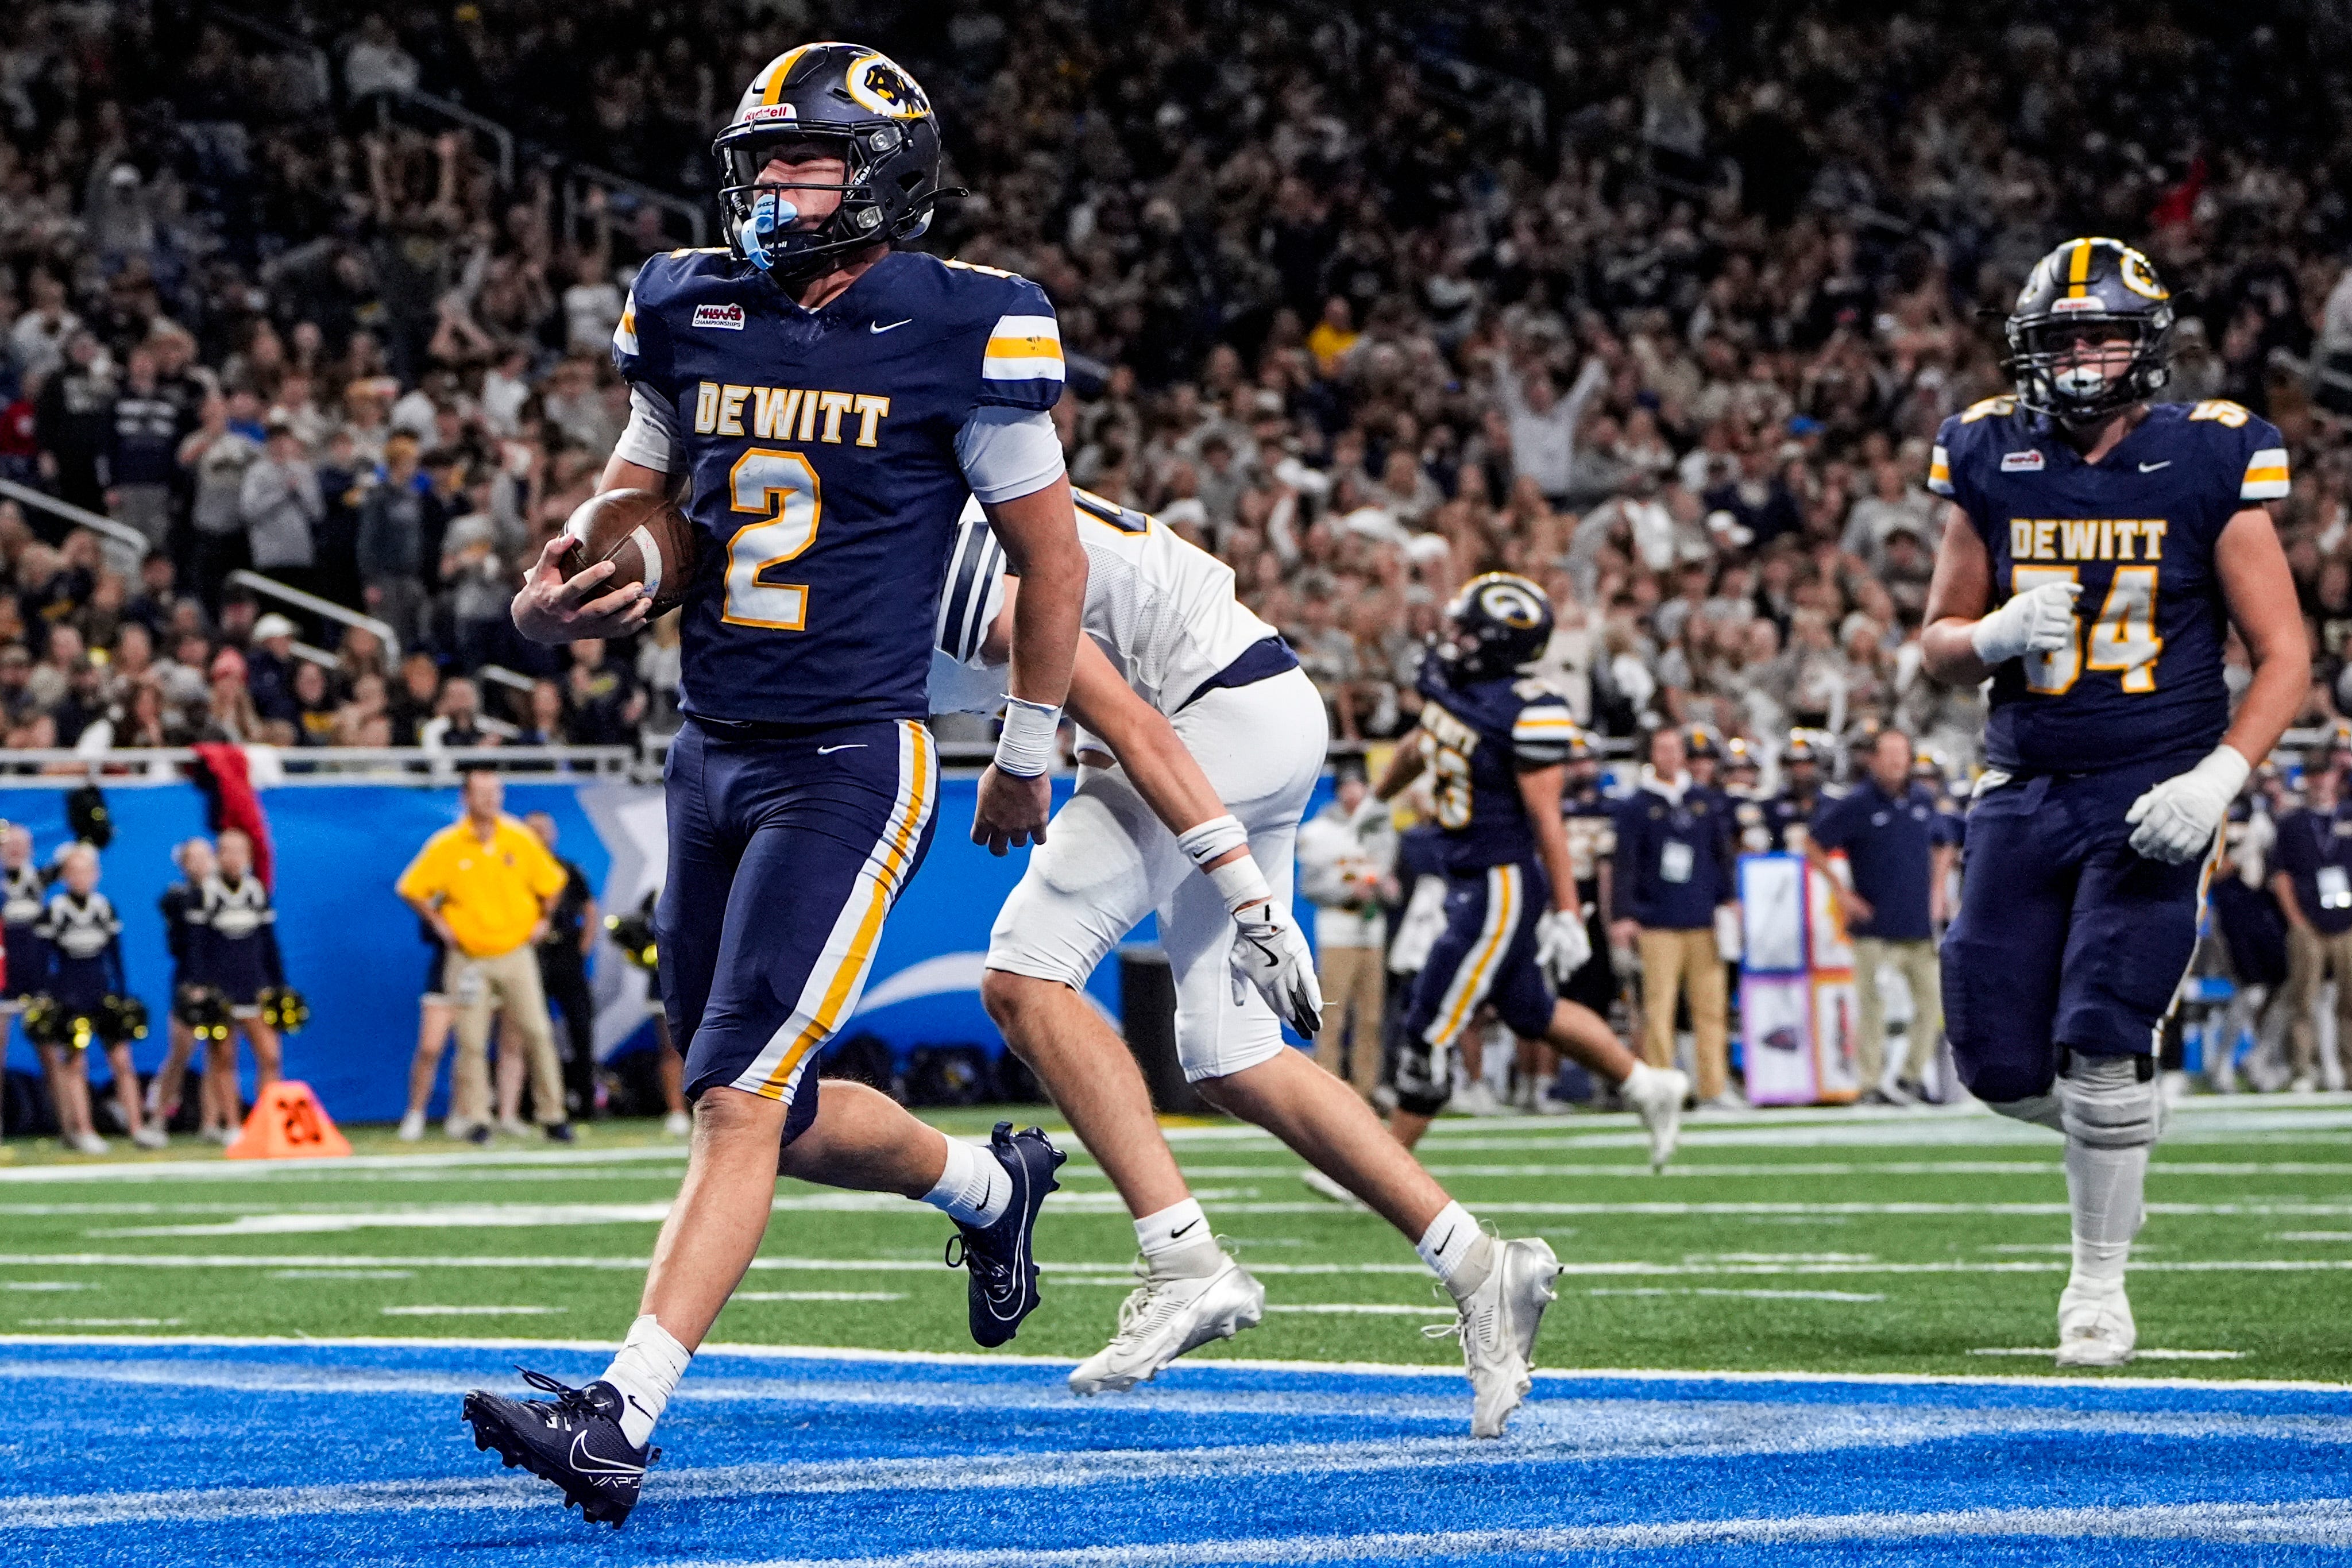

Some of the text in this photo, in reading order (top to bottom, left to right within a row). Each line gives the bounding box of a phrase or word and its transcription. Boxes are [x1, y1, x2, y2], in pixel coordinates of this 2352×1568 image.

[694, 382, 890, 447] DEWITT
[721, 447, 821, 631] 2
[2010, 519, 2168, 561] DEWITT
[588, 1476, 642, 1489] VAPO
